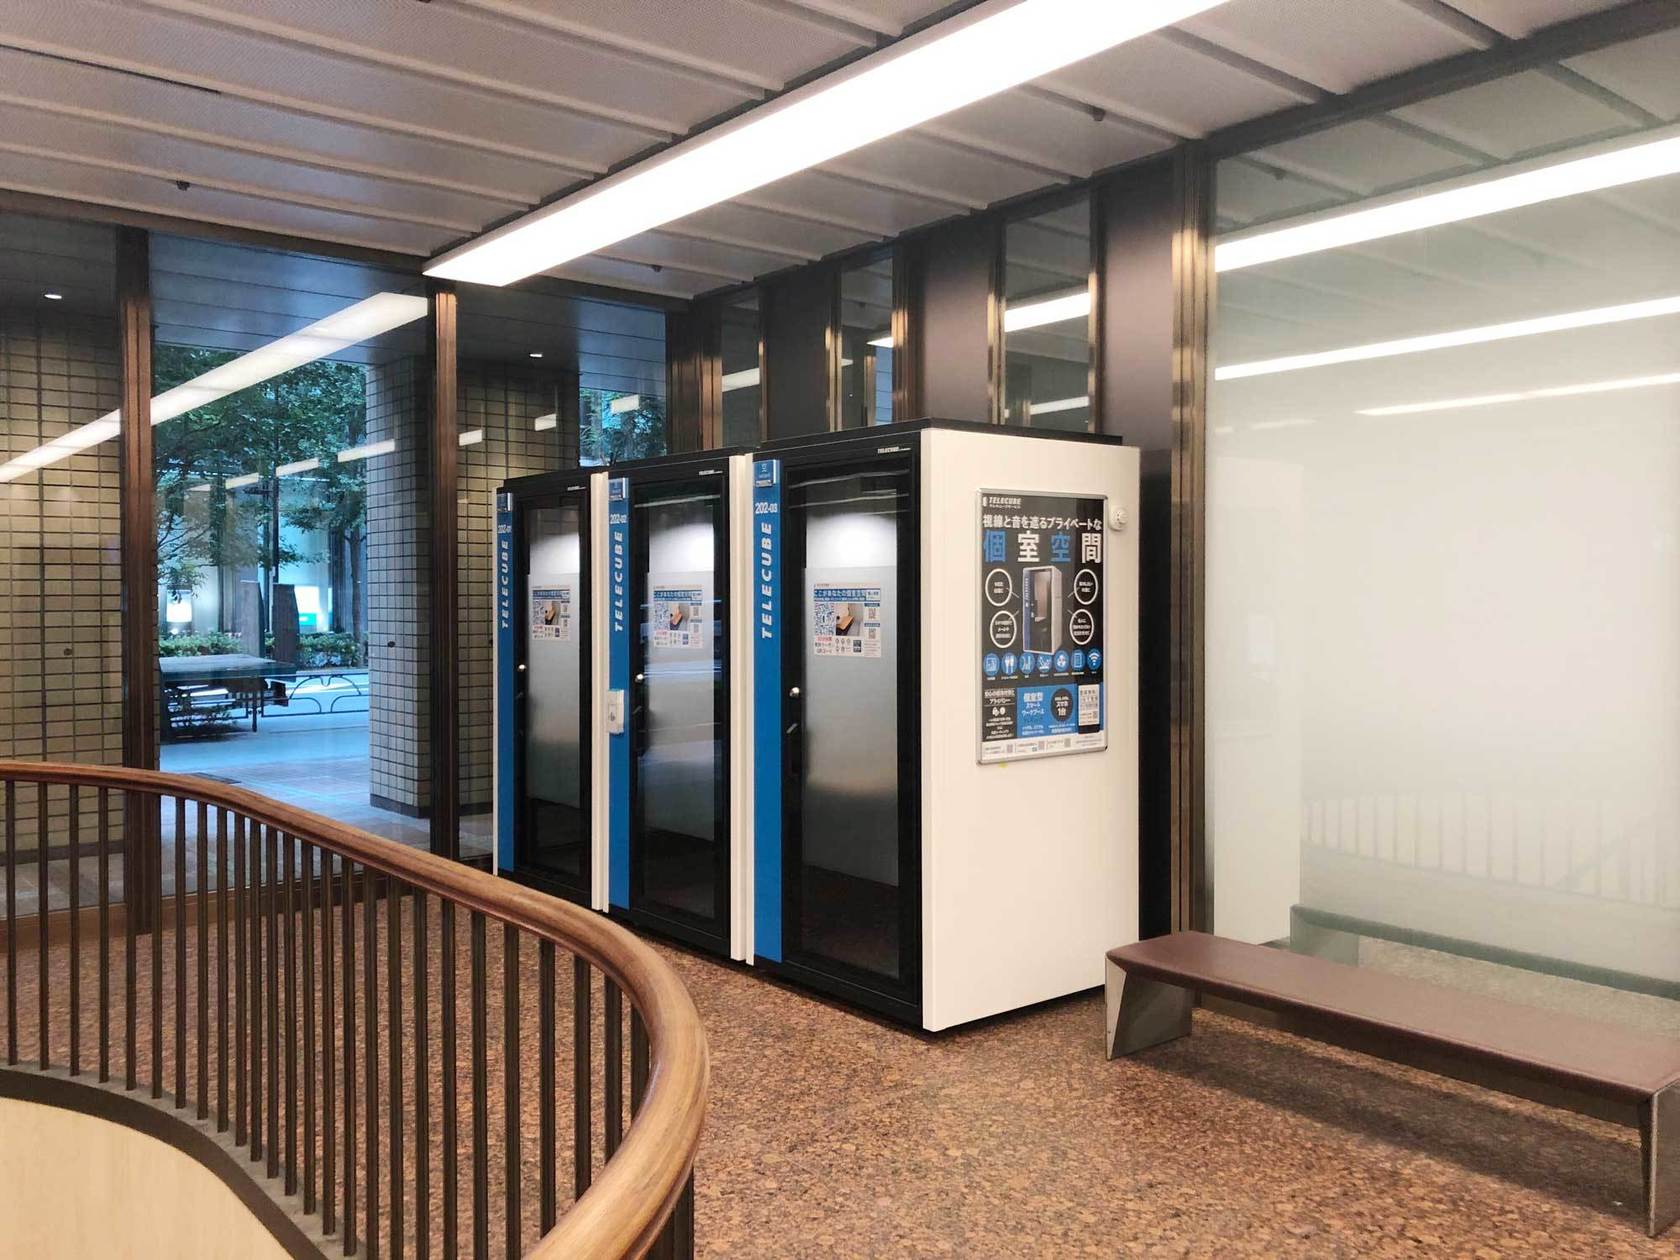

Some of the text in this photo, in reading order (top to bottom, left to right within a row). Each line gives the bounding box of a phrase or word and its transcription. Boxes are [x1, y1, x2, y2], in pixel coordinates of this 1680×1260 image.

[755, 502, 778, 514] 202-03
[983, 513, 1103, 531] 視線と音を遮るプライベートな
[984, 529, 1102, 564] 個室空間
[501, 540, 510, 629] TELECUBE
[614, 531, 624, 632] TELECUBE
[761, 522, 773, 640] TELECUBE
